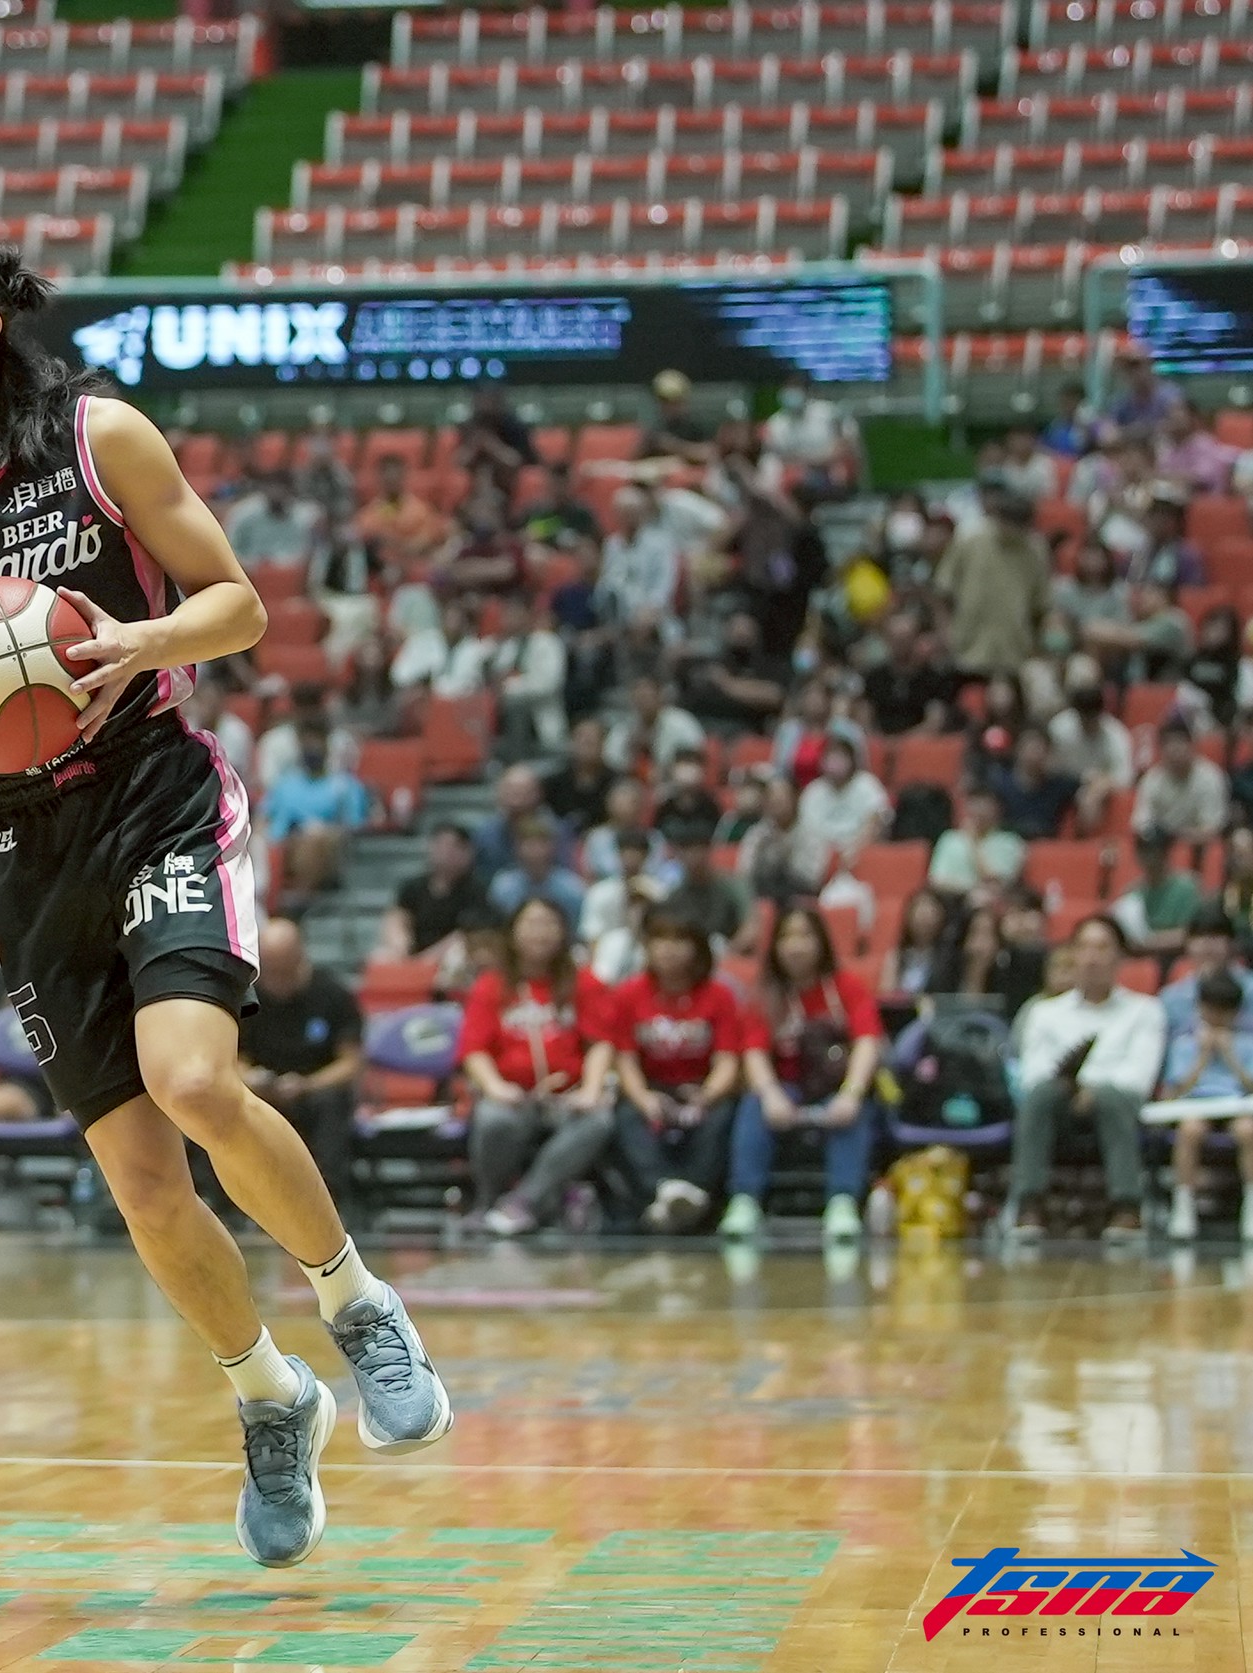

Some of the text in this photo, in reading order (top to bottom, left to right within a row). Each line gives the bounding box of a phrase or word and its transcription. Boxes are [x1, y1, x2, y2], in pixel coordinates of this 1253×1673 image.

[151, 301, 347, 370] UNIX
[1, 510, 65, 549] BEER
[122, 873, 214, 937] ONE
